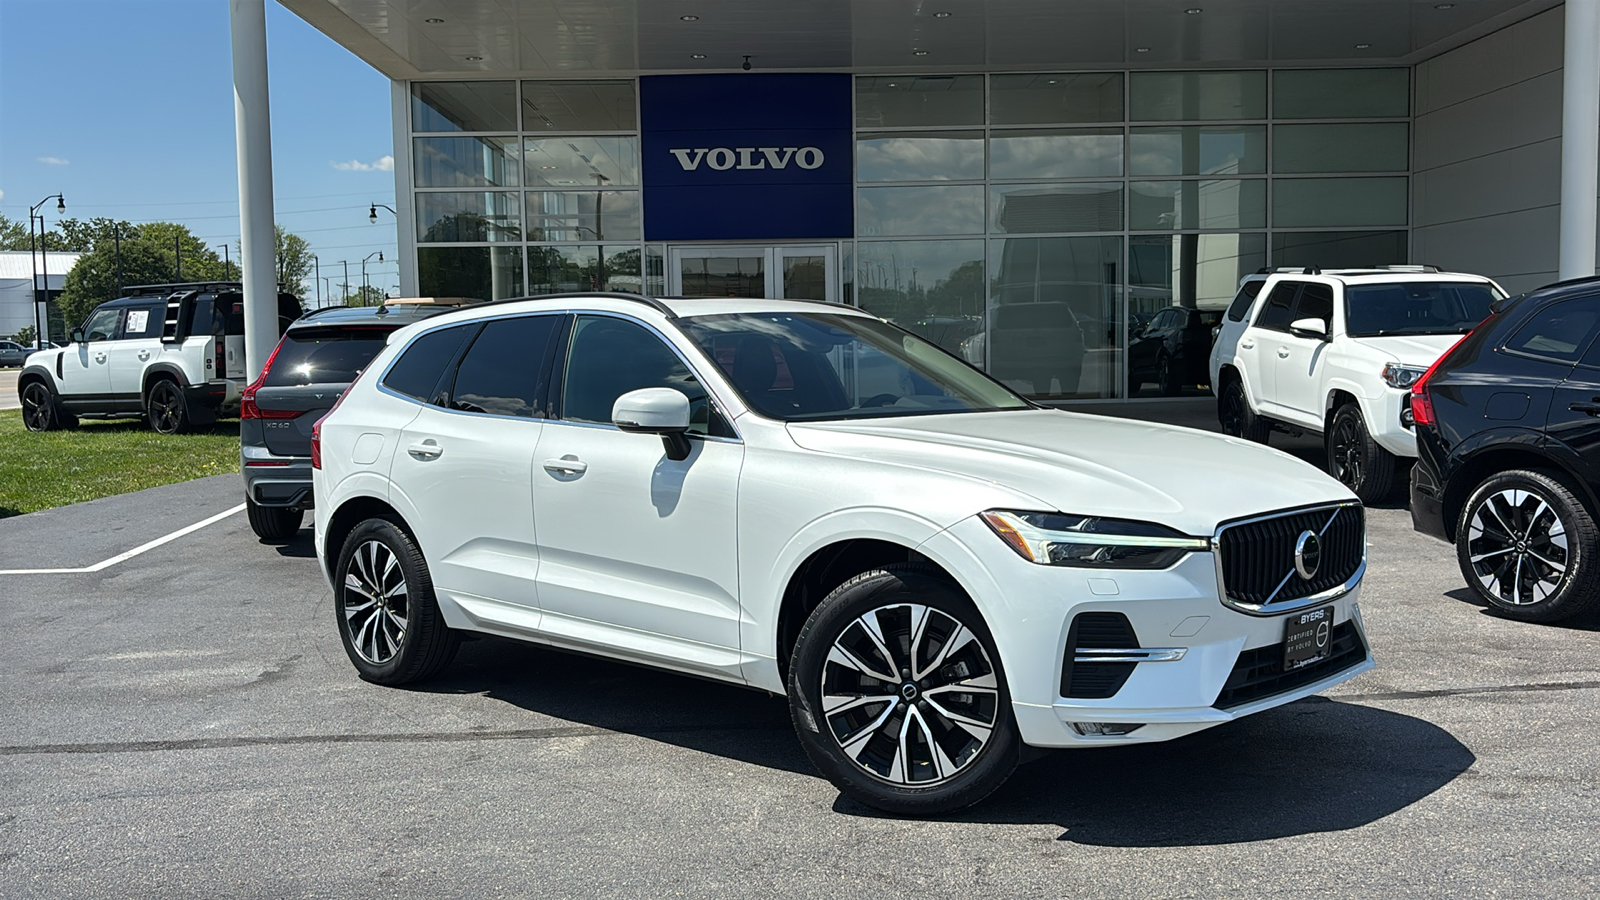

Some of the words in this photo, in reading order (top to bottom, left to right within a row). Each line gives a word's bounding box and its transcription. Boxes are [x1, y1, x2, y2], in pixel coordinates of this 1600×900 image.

[669, 147, 825, 171] VOLVO
[1301, 609, 1325, 624] BYERS
[1287, 629, 1313, 643] CERTIFIED
[1295, 640, 1312, 651] VOLVO
